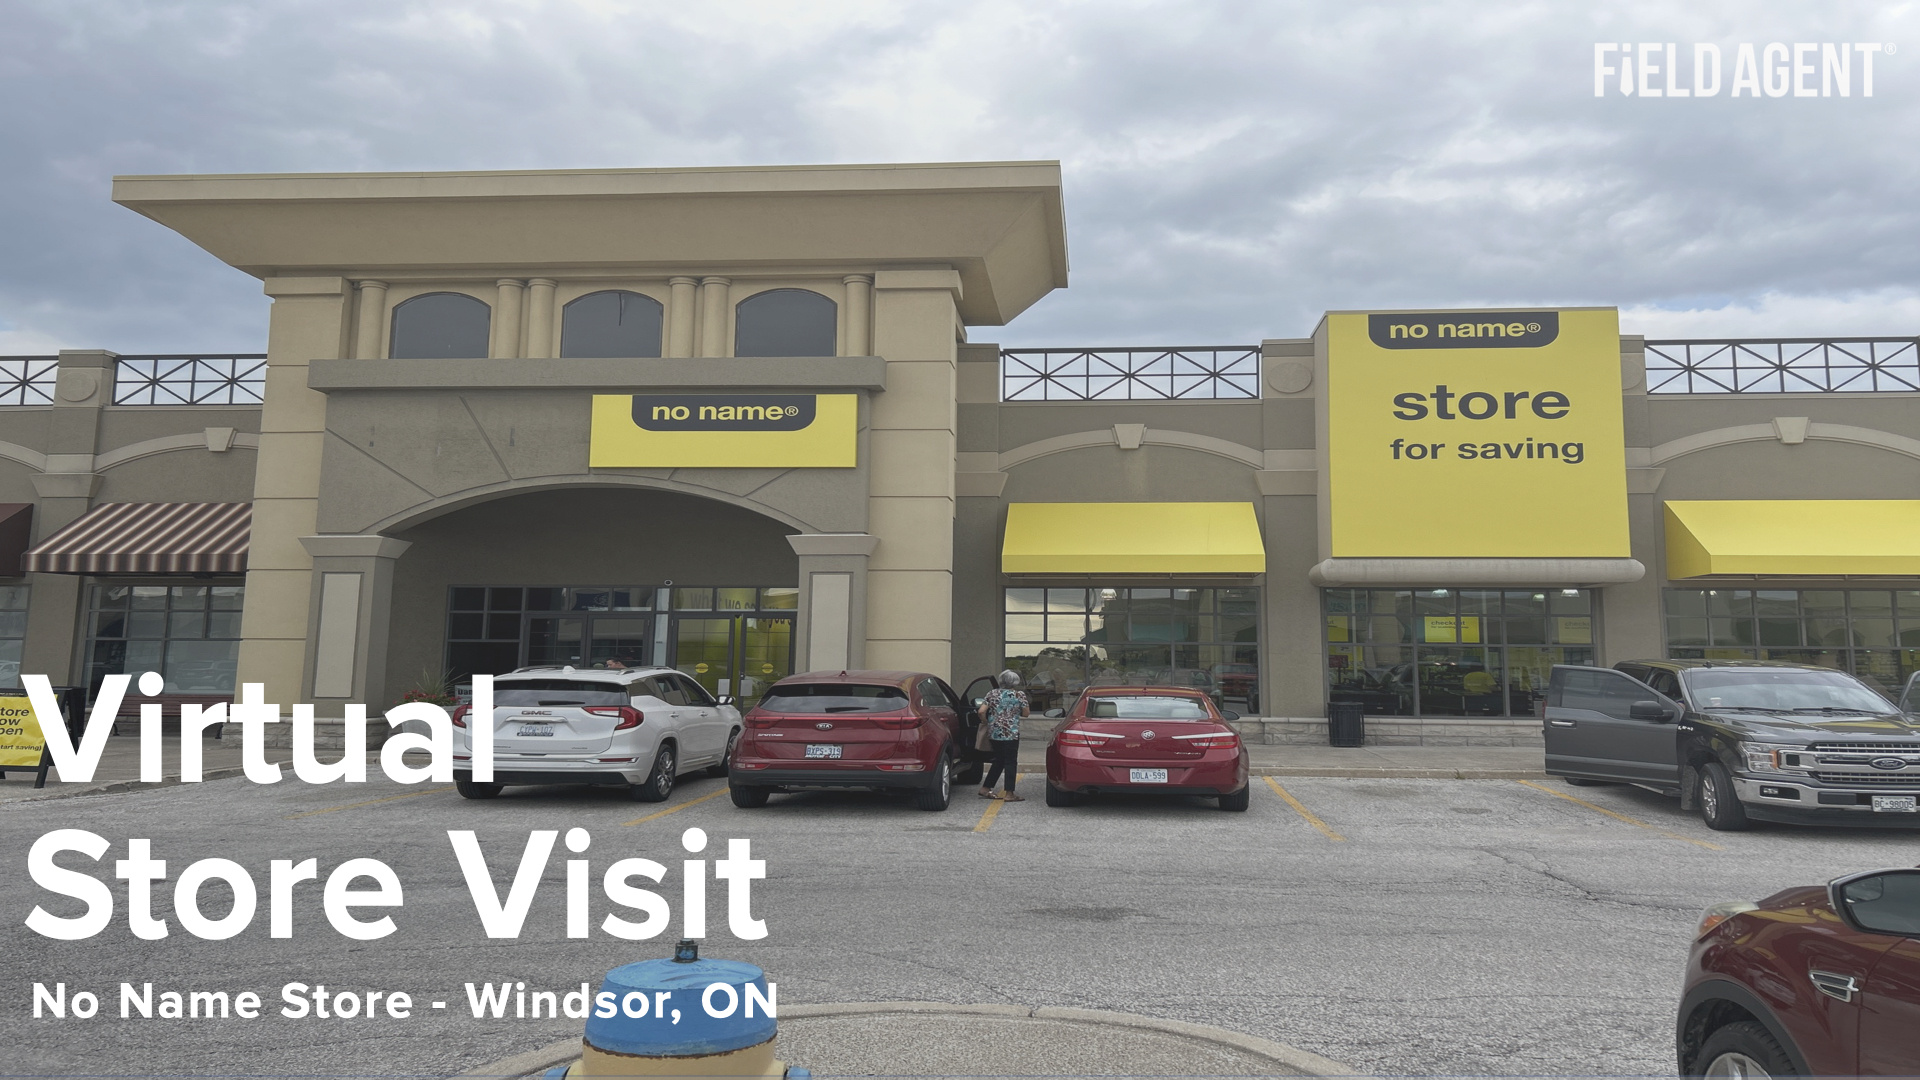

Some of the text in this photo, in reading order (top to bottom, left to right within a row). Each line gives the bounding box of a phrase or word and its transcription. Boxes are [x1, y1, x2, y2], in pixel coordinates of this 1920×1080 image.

[1390, 323, 1429, 339] no
[1393, 385, 1570, 420] store
[652, 406, 690, 421] no
[1390, 437, 1584, 464] for saving
[0, 706, 30, 717] tore
[0, 718, 21, 726] ow
